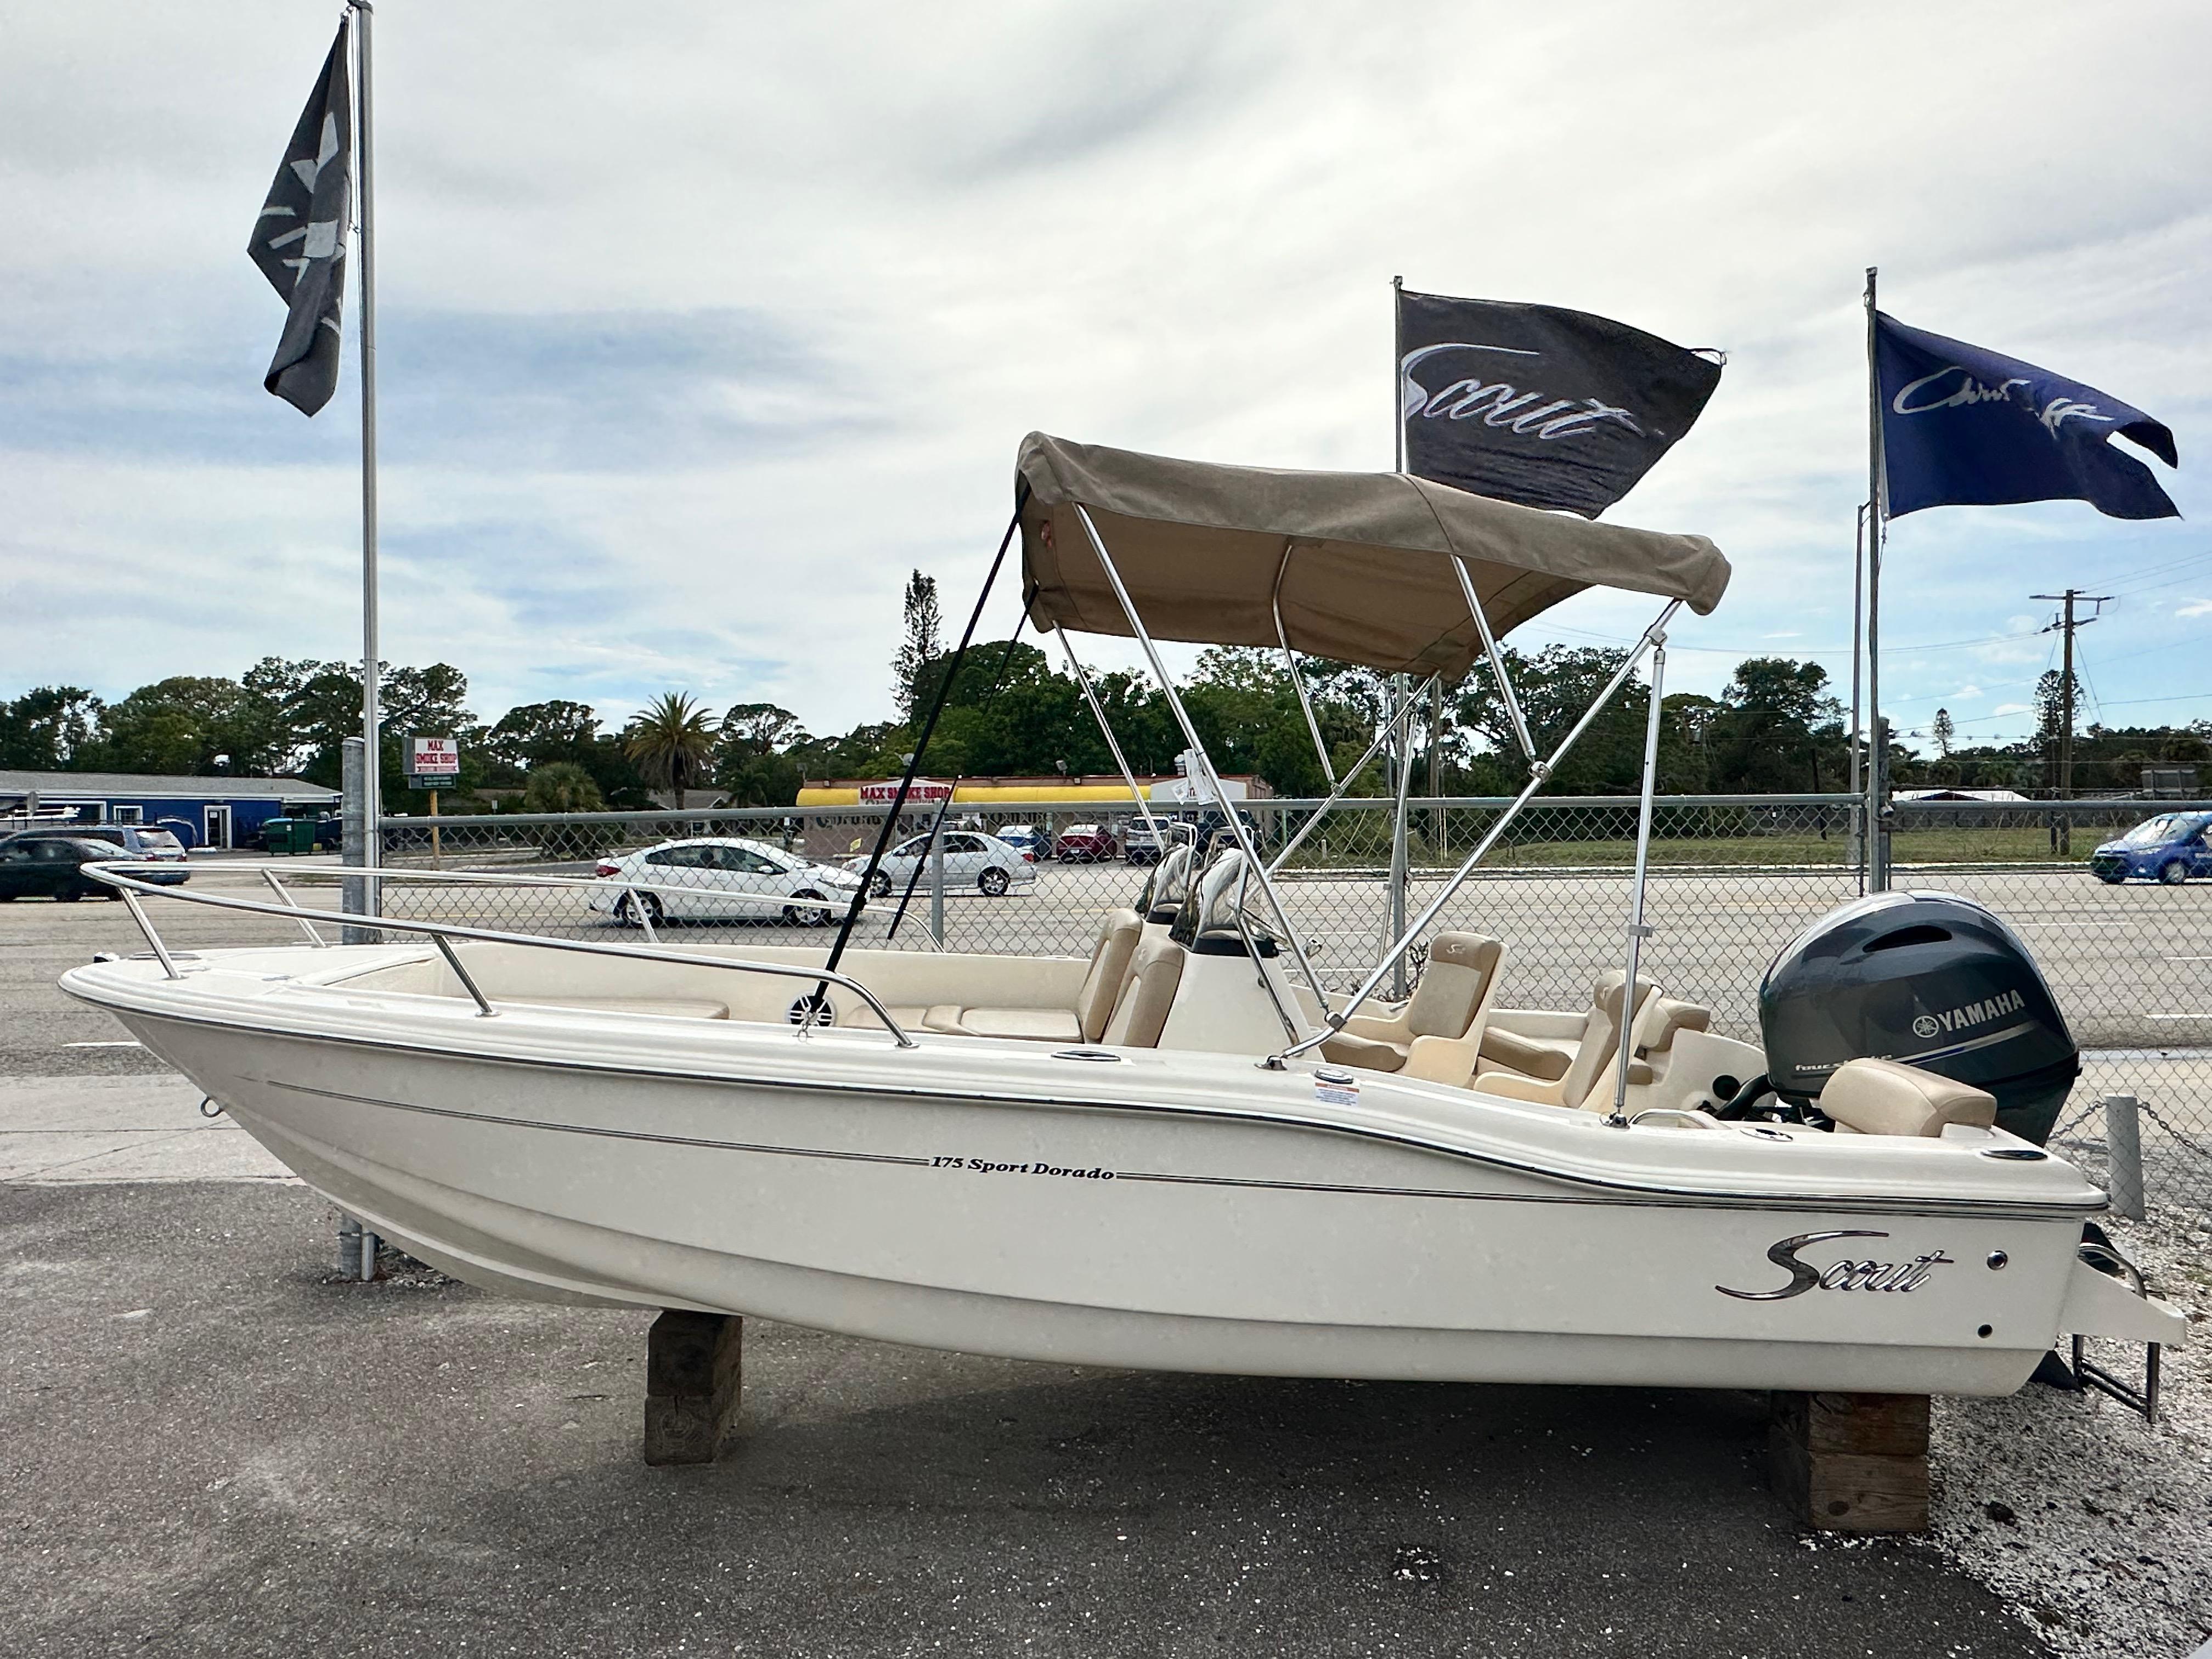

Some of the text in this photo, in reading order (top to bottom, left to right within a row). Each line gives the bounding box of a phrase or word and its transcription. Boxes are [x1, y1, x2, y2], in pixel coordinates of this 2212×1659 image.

[1401, 342, 1646, 441] Scout
[427, 740, 444, 751] MAX
[416, 753, 456, 764] SMOKE SHOP
[860, 787, 950, 799] MAX SMKE SHOP
[1938, 989, 2025, 1031] YAMAHA
[931, 1156, 1115, 1180] 175 Sport Dorado
[1715, 1230, 1954, 1301] Scout
